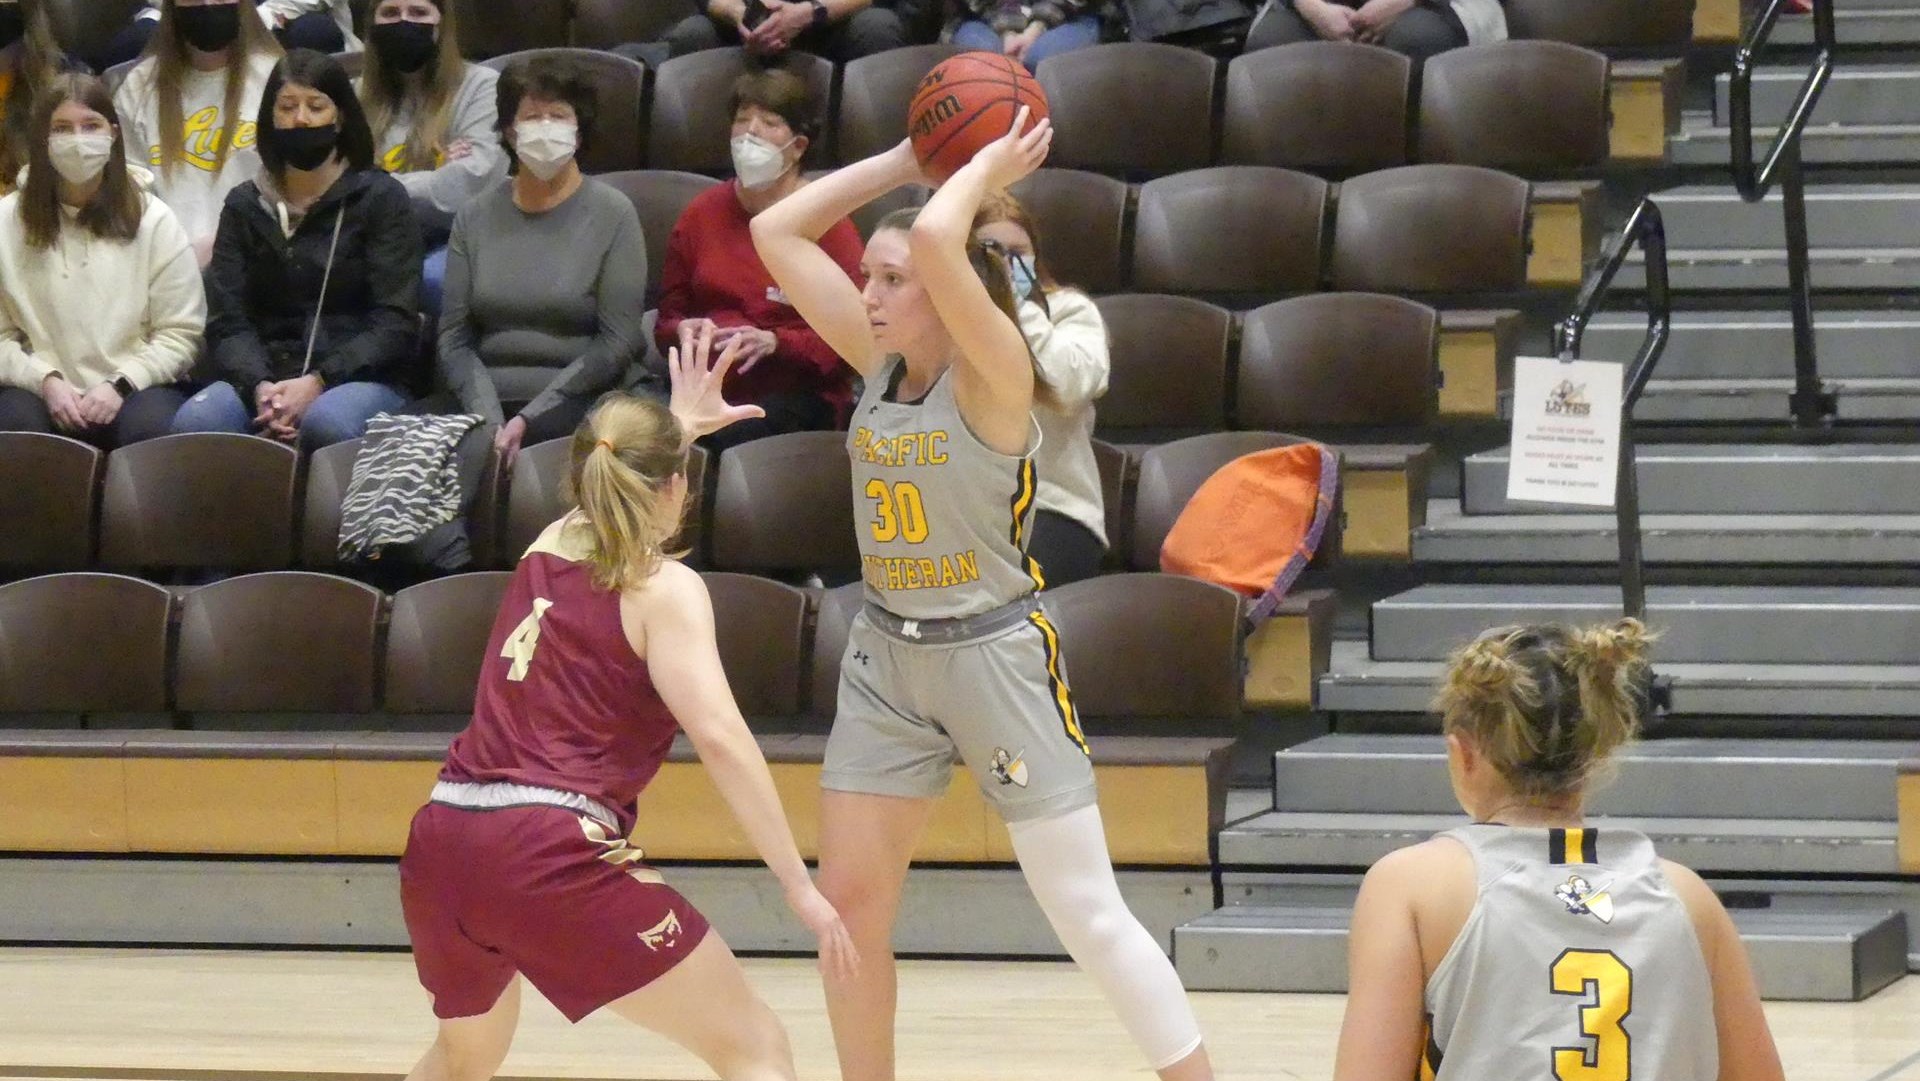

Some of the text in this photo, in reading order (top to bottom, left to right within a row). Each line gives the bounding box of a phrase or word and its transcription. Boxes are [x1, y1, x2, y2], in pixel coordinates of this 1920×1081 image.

[852, 426, 949, 468] PACIFIC
[865, 478, 930, 544] 30
[500, 597, 554, 682] 4
[1549, 948, 1633, 1081] 3
